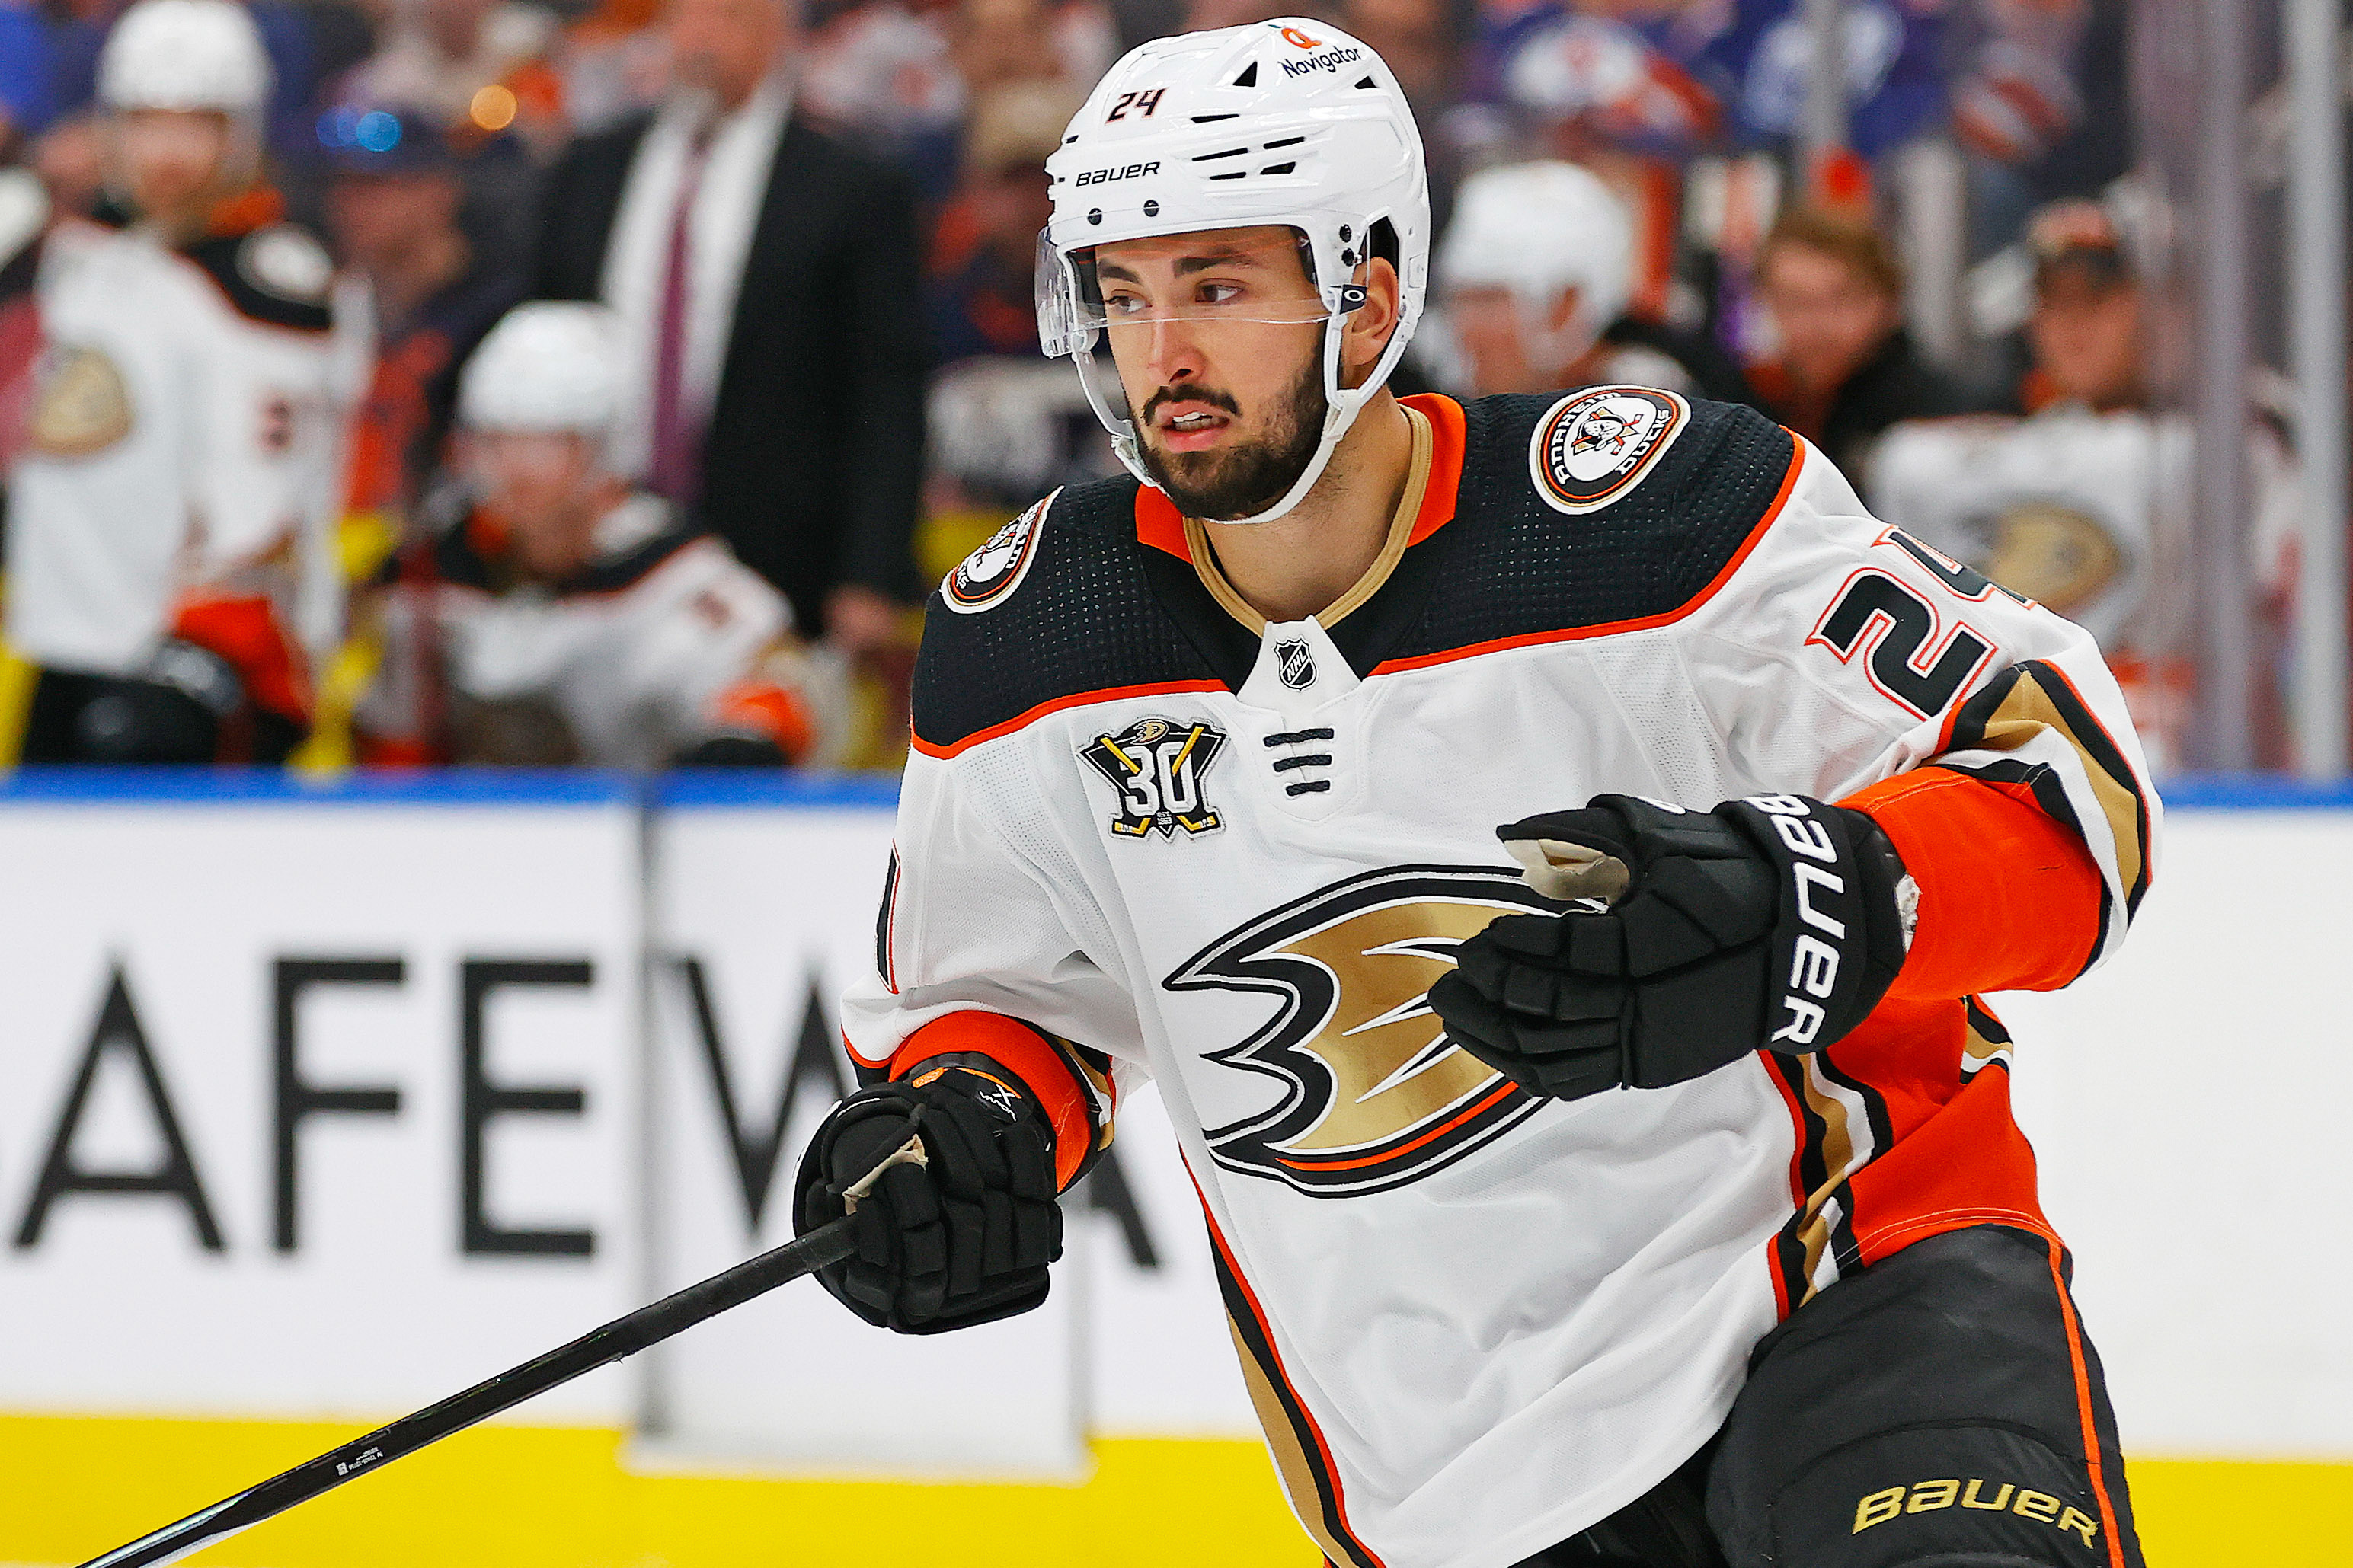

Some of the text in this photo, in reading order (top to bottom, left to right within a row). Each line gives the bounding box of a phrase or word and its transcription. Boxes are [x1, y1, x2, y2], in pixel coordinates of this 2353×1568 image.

[1281, 45, 1362, 78] Navigator
[1105, 87, 1168, 126] 24
[1615, 408, 1673, 475] DUCKS
[1286, 650, 1307, 681] NHL
[1118, 741, 1198, 817] 30
